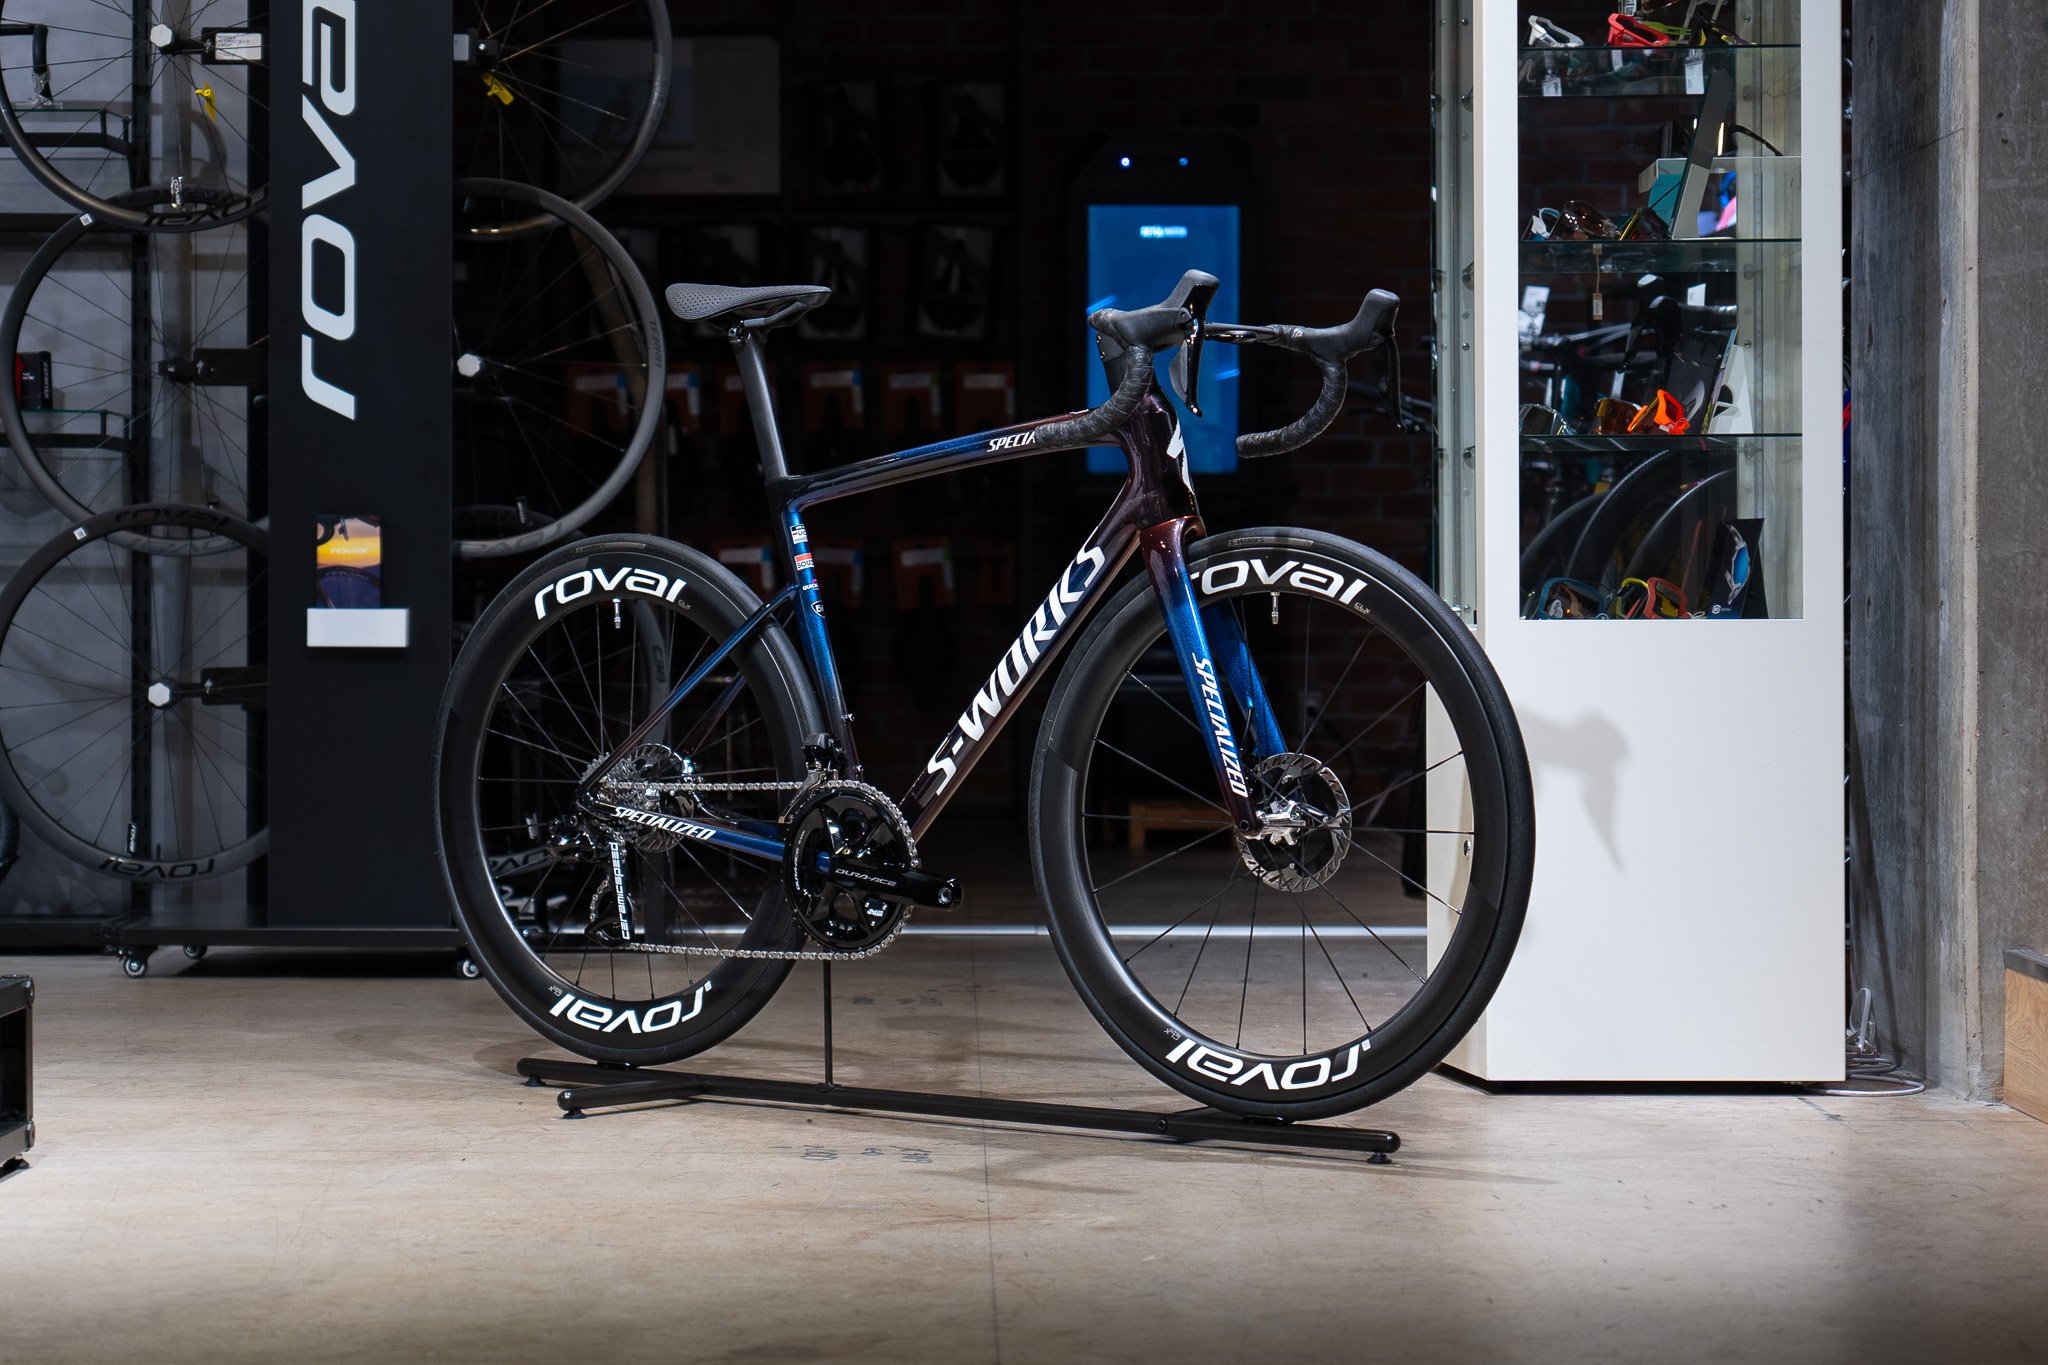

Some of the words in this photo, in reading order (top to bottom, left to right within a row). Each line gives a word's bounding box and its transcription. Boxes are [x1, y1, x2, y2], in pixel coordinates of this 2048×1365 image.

[534, 567, 687, 621] roval
[1190, 558, 1368, 605] oval
[927, 524, 1106, 796] S-WORKS
[1192, 652, 1249, 798] SPECIALIZED
[611, 806, 717, 840] SPECIALIZED
[98, 857, 215, 879] roval
[835, 867, 898, 887] DURA-ACE
[549, 986, 704, 1034] roval
[1165, 1038, 1360, 1091] roval
